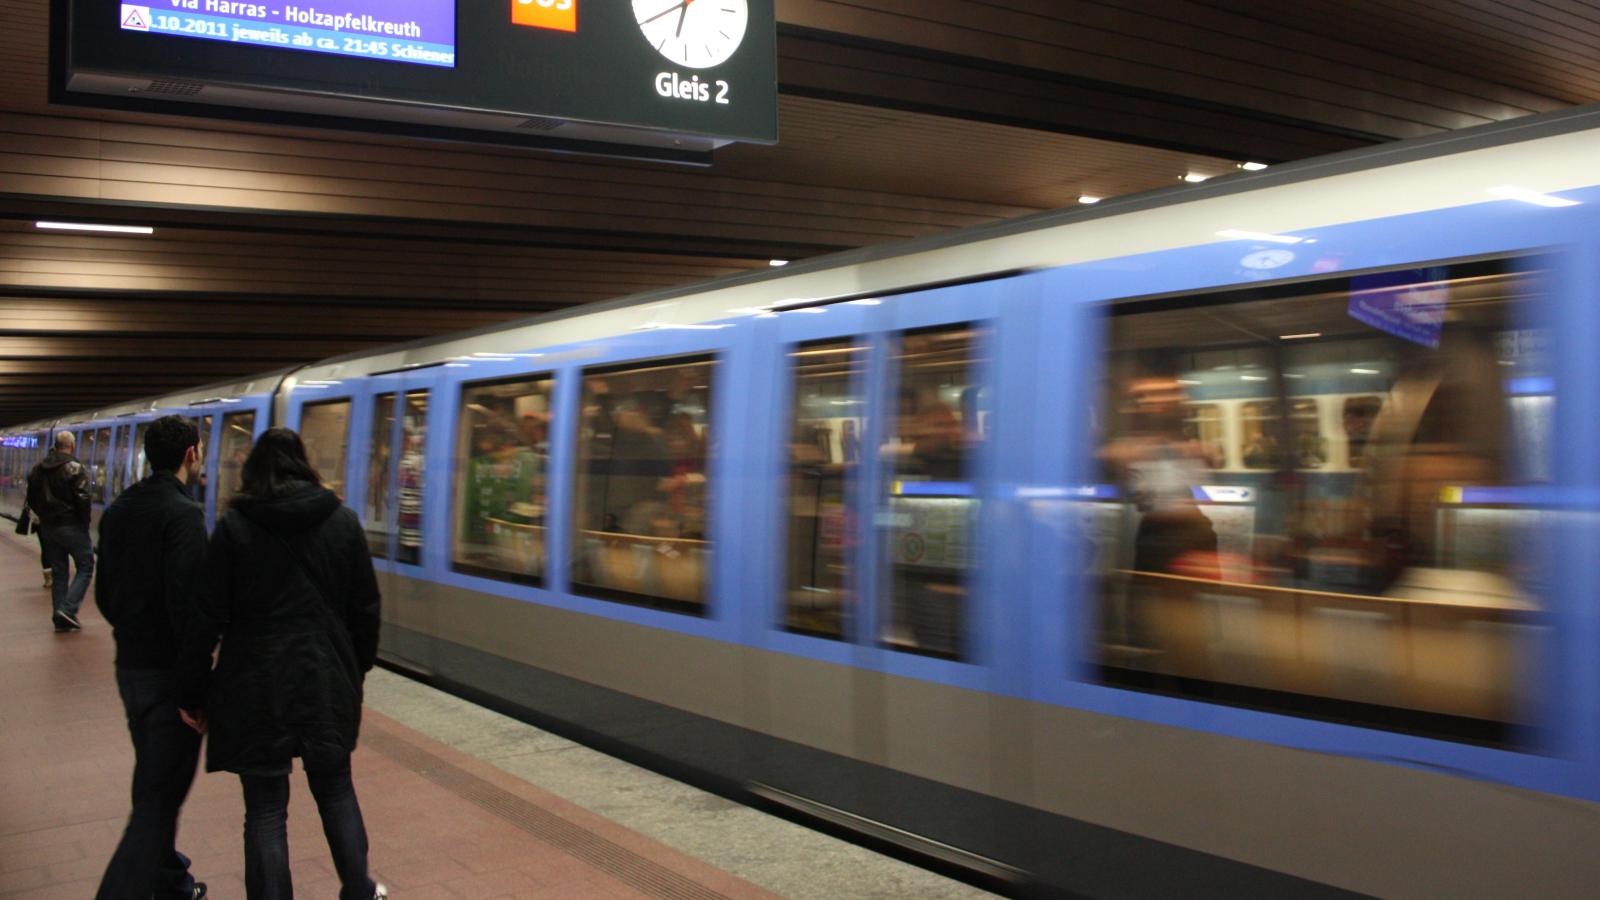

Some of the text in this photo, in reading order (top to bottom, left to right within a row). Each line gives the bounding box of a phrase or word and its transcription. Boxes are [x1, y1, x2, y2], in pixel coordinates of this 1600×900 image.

[206, 0, 267, 18] Harras
[285, 5, 421, 38] Holzapfelkreuth
[231, 24, 289, 44] jeweils
[292, 32, 313, 47] ab
[316, 37, 340, 50] ca.
[343, 37, 389, 56] 21:45
[655, 72, 729, 104] Gleis 2
